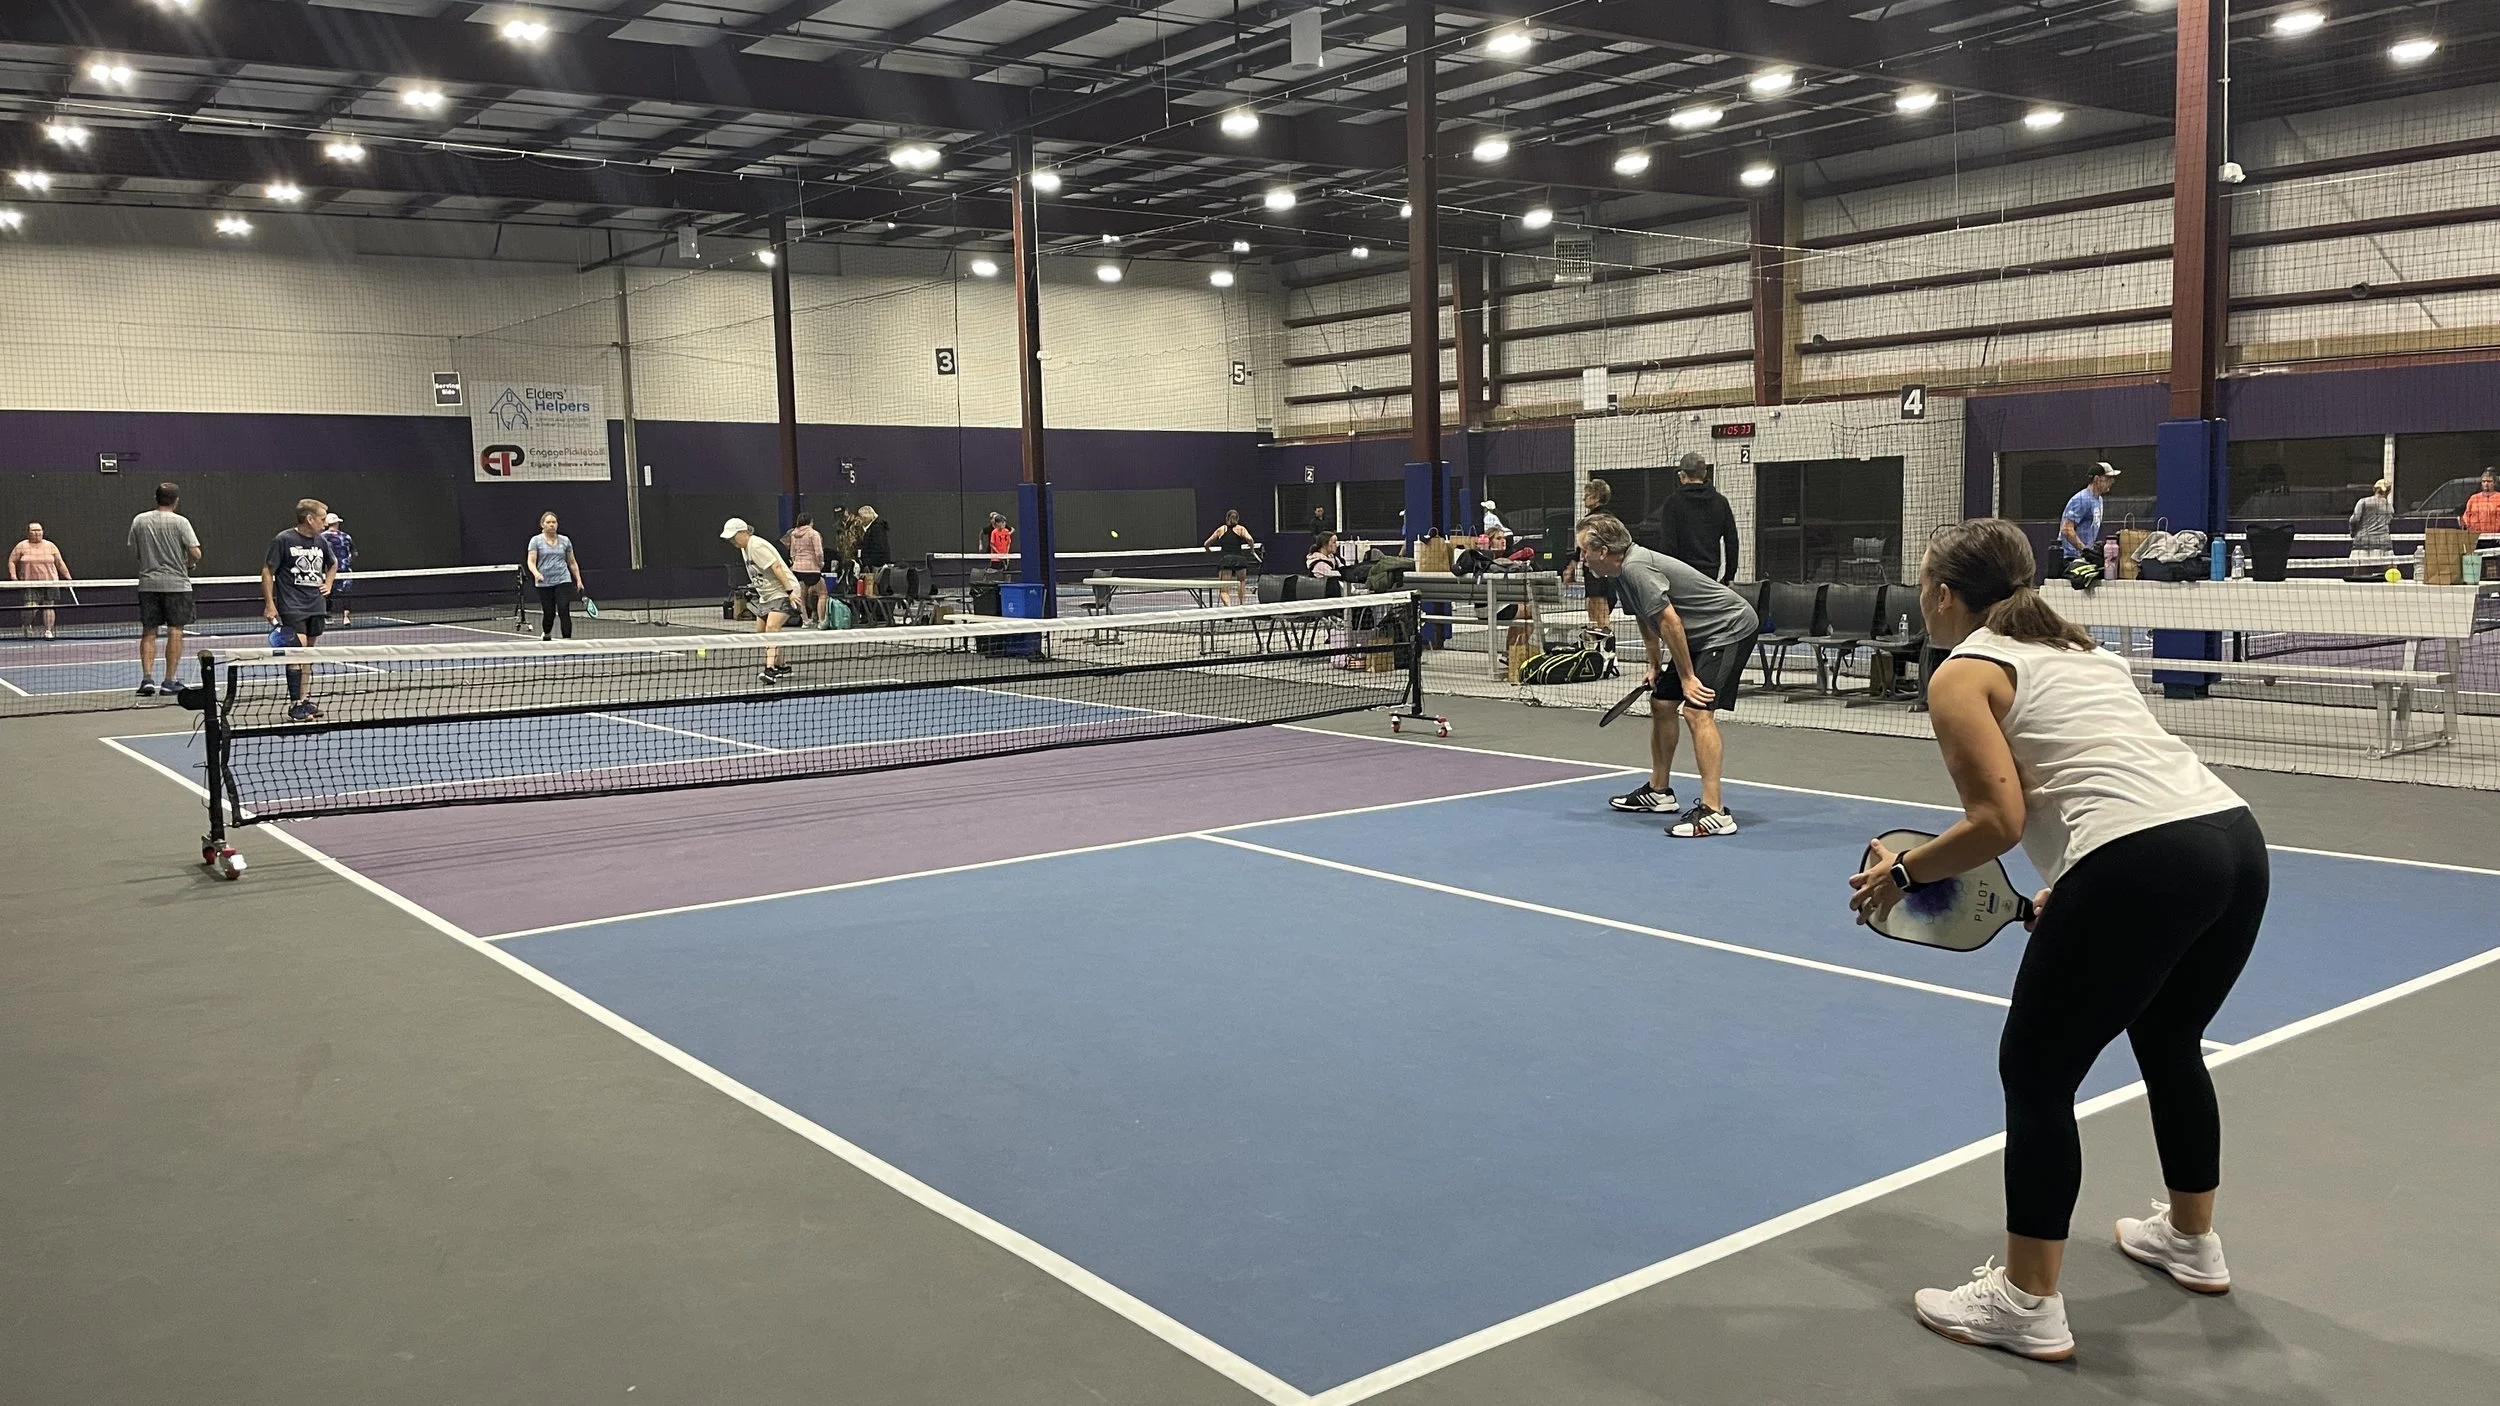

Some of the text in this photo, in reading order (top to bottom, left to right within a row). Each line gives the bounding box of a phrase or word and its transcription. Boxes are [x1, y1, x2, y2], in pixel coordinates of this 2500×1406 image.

[938, 351, 953, 372] 3
[1234, 364, 1245, 382] 5
[534, 399, 590, 413] Helpers
[1903, 388, 1923, 415] 4
[1742, 450, 1749, 462] 2
[849, 469, 856, 484] 5
[1974, 880, 1989, 922] PILOT
